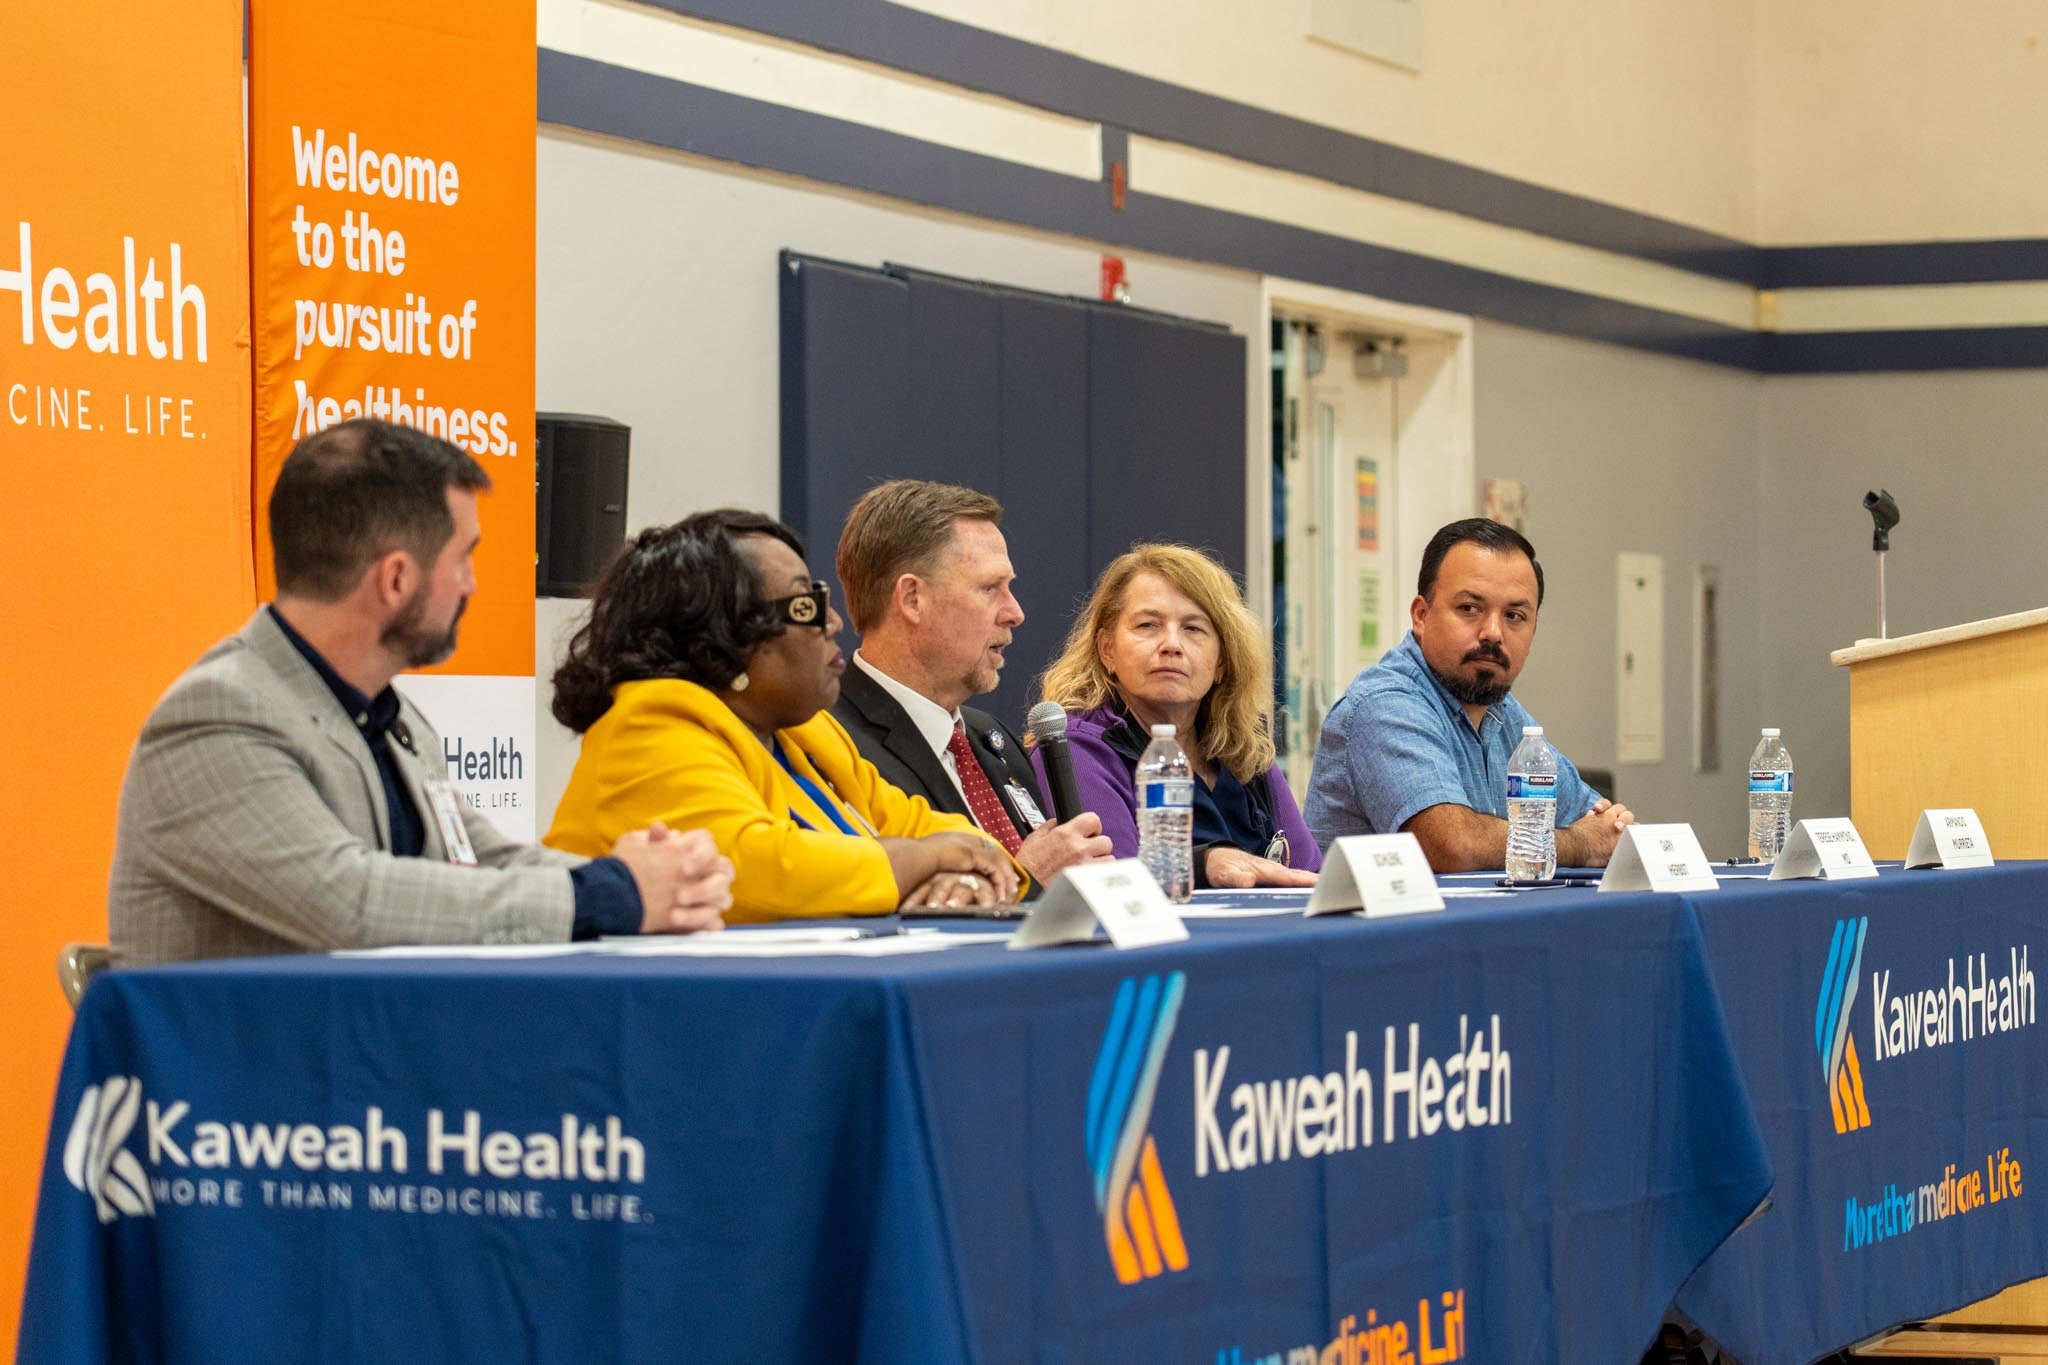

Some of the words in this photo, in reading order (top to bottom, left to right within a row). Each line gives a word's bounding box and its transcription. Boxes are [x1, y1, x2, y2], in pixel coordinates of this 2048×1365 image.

[291, 125, 460, 207] Welcome
[291, 204, 335, 269] to
[340, 210, 406, 276] the
[294, 292, 432, 361] pursuit
[438, 299, 477, 360] of
[8, 383, 104, 432] CINE.
[124, 393, 207, 440] LIFE.
[443, 736, 523, 780] Health
[491, 792, 523, 808] LIFE.
[1873, 958, 1967, 1062] Kaweah
[1967, 944, 2036, 1039] Health
[1194, 1030, 1374, 1178] Kaweah
[146, 1098, 408, 1175] Kaweah
[427, 1106, 646, 1184] Health
[152, 1176, 244, 1207] MORE
[261, 1179, 353, 1210] THAN
[367, 1183, 558, 1220] MEDICINE.
[570, 1192, 656, 1225] LIFE.
